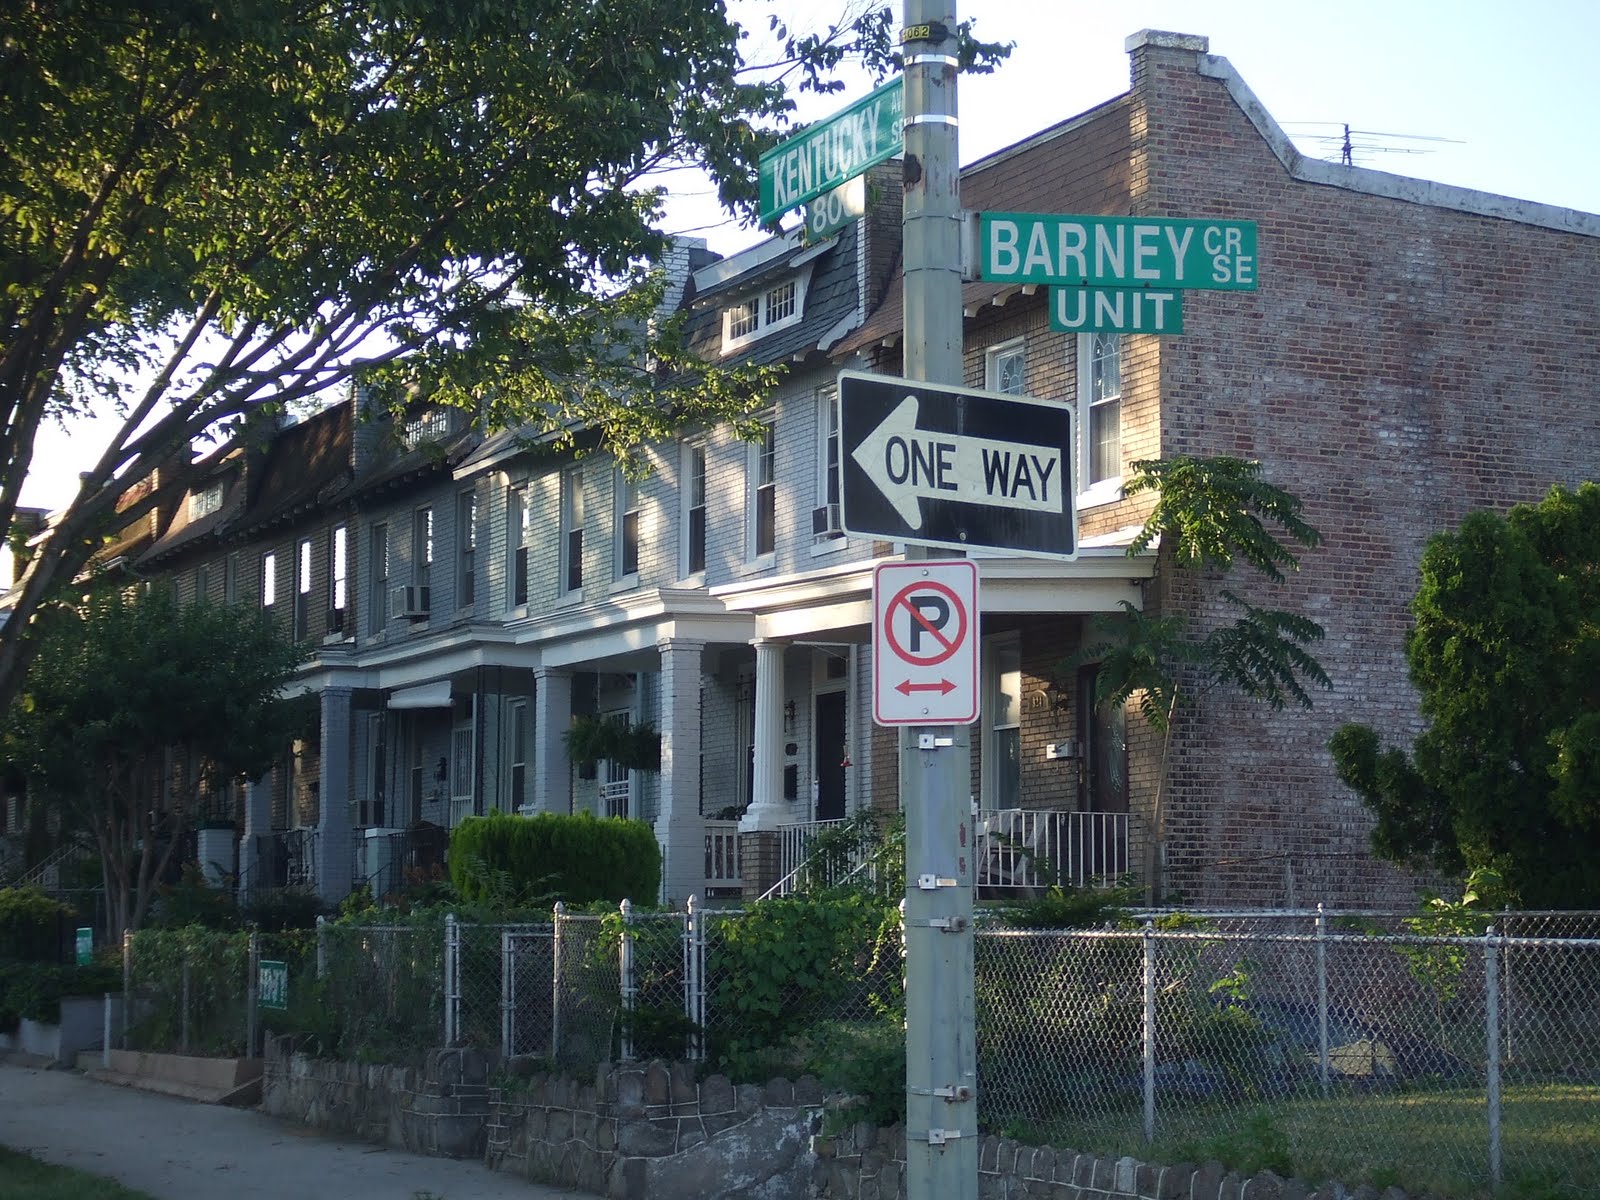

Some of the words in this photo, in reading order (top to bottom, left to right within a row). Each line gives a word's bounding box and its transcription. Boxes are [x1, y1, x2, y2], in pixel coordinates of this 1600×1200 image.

[773, 101, 881, 209] KENTUCKY
[990, 220, 1194, 281] BARNEY
[1203, 226, 1242, 255] CR
[1212, 254, 1253, 284] SE
[1057, 289, 1174, 329] UNIT
[885, 435, 958, 491] ONE
[982, 448, 1057, 502] WAY
